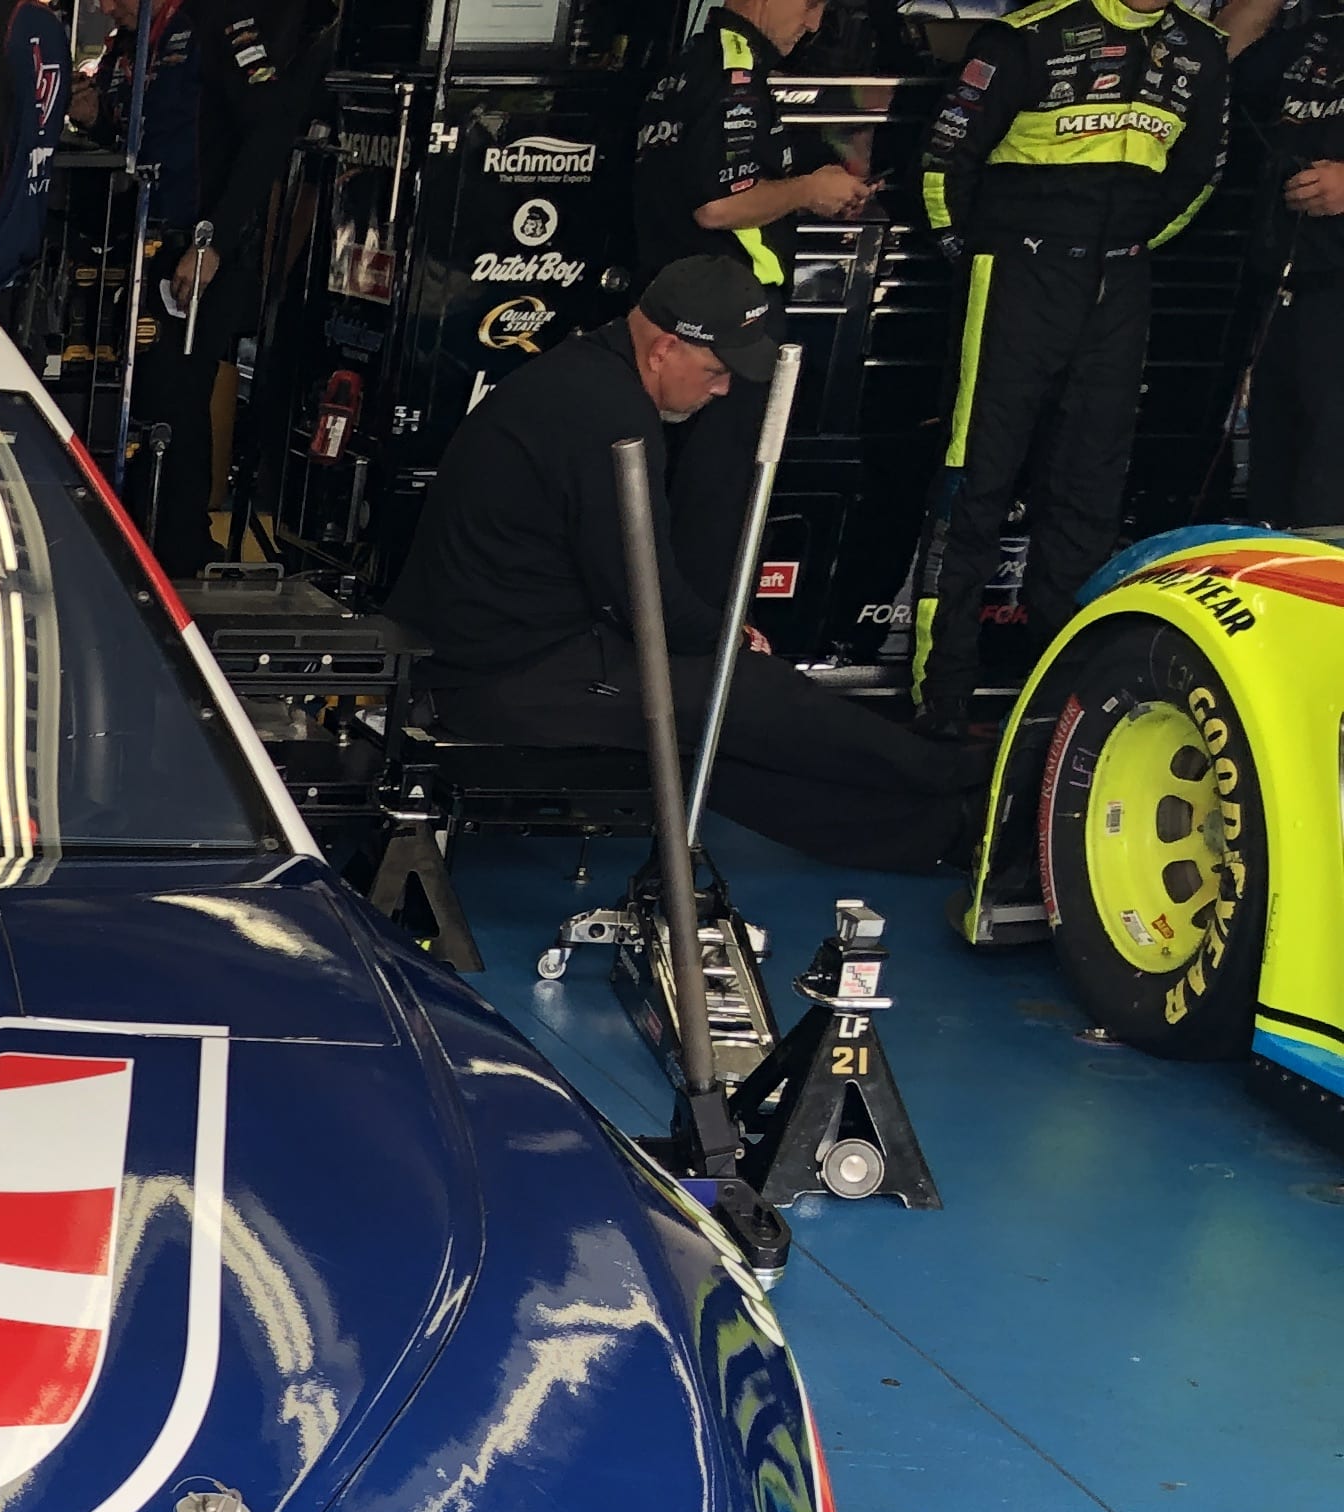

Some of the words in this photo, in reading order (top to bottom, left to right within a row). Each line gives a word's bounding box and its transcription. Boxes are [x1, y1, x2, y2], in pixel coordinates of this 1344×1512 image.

[1059, 111, 1173, 137] MENARDS
[484, 144, 596, 172] Richmond
[719, 168, 735, 183] 21
[471, 252, 539, 282] Dutch
[538, 252, 585, 288] Boy
[499, 309, 556, 322] QUAKER
[503, 321, 541, 332] STATE
[839, 1017, 869, 1038] LF
[832, 1046, 868, 1075] 21
